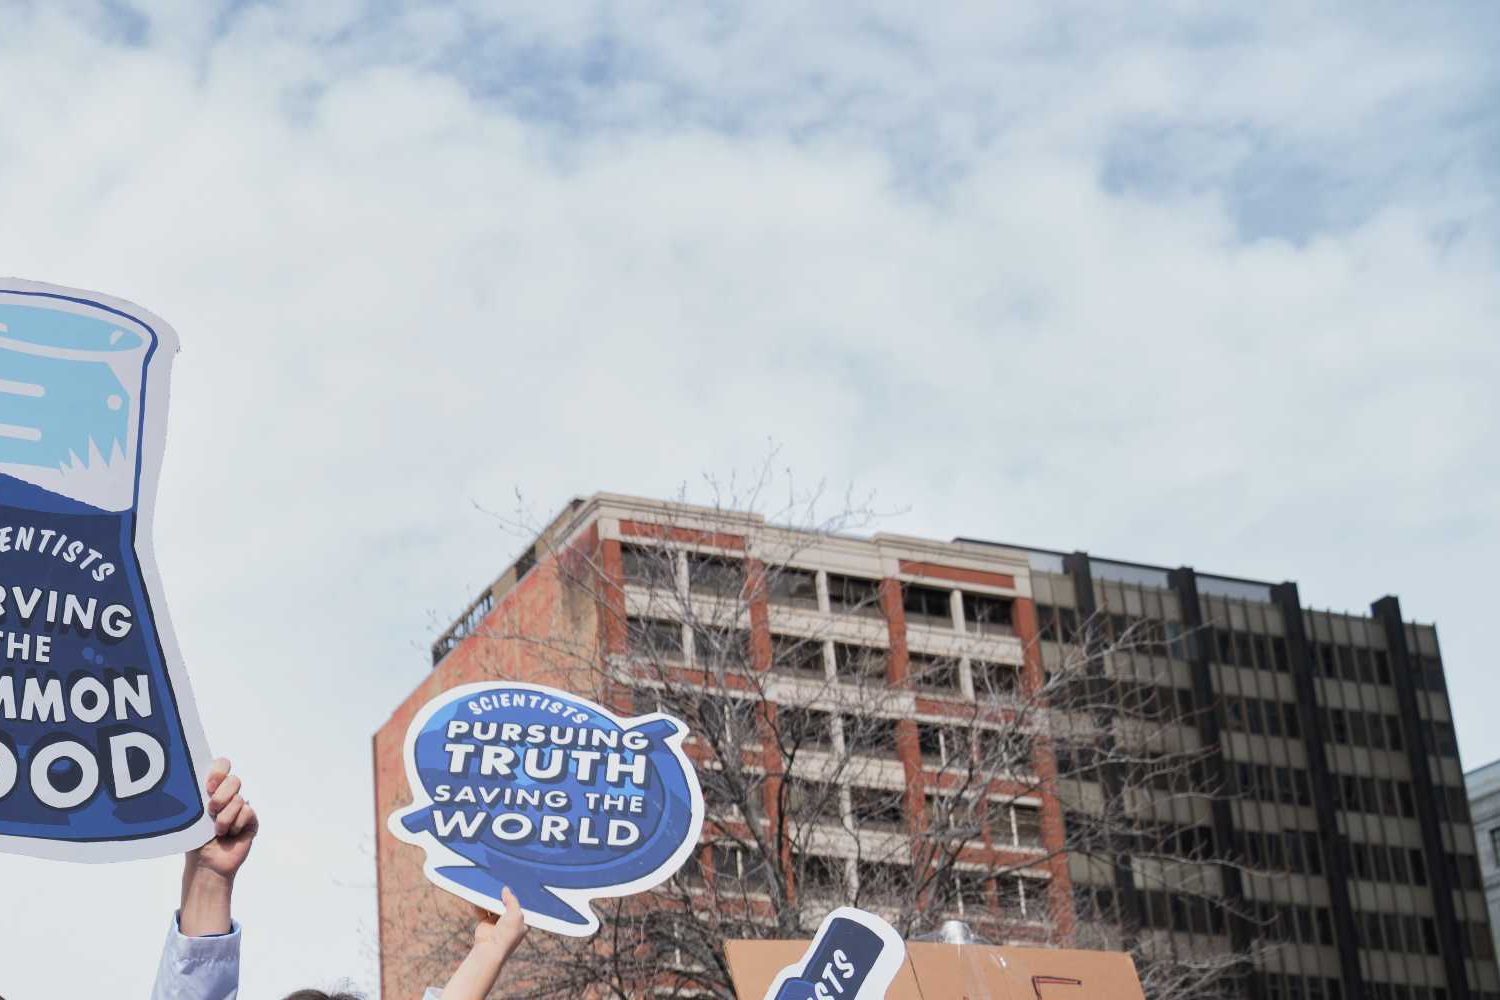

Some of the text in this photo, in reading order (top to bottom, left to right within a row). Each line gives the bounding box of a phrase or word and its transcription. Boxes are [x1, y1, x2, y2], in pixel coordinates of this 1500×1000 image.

[468, 693, 590, 724] SCIENTISTS
[446, 720, 649, 750] PURSUING
[445, 743, 646, 784] TRUTH
[434, 785, 644, 814] SAVING THE
[433, 810, 640, 847] WORLD
